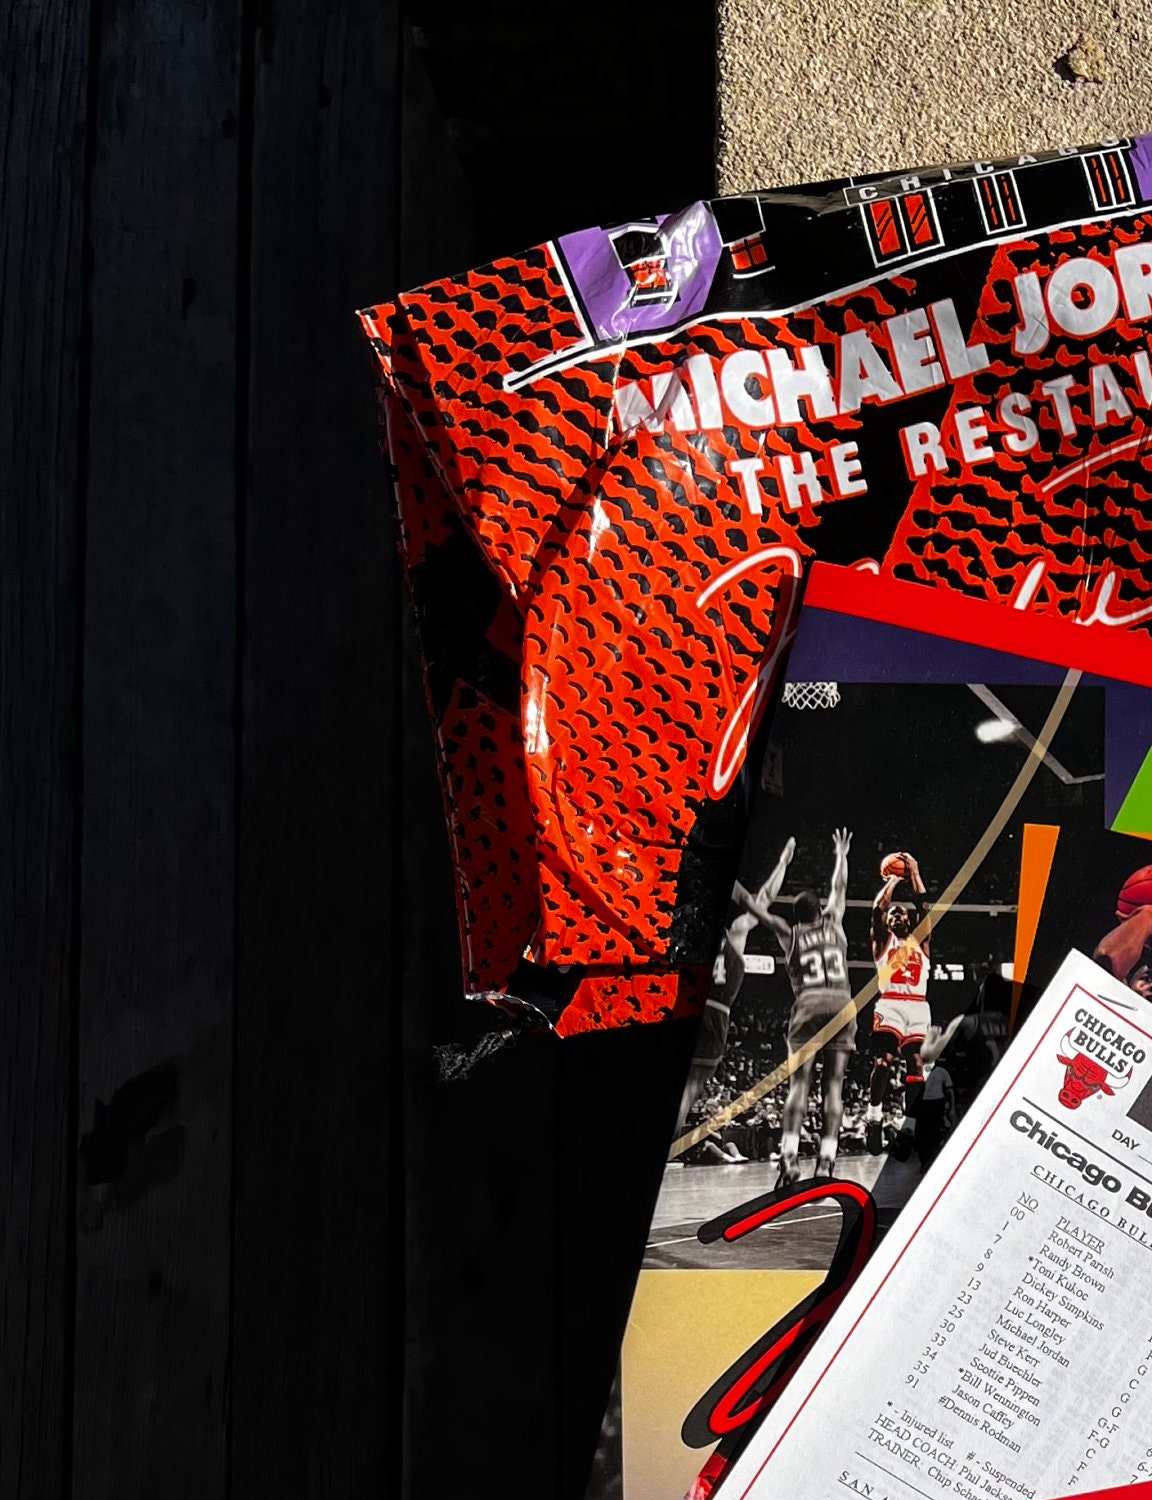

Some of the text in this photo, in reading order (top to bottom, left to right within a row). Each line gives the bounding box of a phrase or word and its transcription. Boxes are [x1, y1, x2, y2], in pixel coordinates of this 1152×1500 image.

[859, 138, 1121, 200] CHICAGO
[615, 298, 990, 439] MICHAEL
[731, 441, 868, 515] THE
[802, 949, 847, 986] 33
[890, 961, 924, 986] 23
[1073, 1030, 1128, 1073] BULLS
[1074, 1008, 1146, 1064] CHICAGO
[1009, 1110, 1121, 1193] Chicago
[1111, 1129, 1140, 1150] DAY
[1016, 1191, 1039, 1212] NO
[1054, 1215, 1105, 1254] PLAYER
[1030, 1165, 1110, 1217] CHICAGO
[993, 1234, 1002, 1244] 7
[1055, 1273, 1088, 1301] Kukoc
[1002, 1221, 1009, 1231] 1
[1039, 1244, 1072, 1272] Randy
[1071, 1264, 1105, 1293] Brown
[1009, 1206, 1025, 1221] 00
[1047, 1230, 1083, 1258] Robert
[1082, 1251, 1114, 1279] Parish
[967, 1277, 981, 1290] 13
[1003, 1300, 1024, 1319] Luc
[1024, 1312, 1066, 1345] Longley
[975, 1262, 984, 1272] 9
[1012, 1286, 1034, 1306] Ron
[1034, 1299, 1071, 1328] Harper
[983, 1248, 993, 1259] 8
[1021, 1271, 1058, 1302] Dickey
[1058, 1295, 1104, 1330] Simpkins
[939, 1318, 1042, 1387] 30 Jud Buechler
[948, 1304, 1040, 1368] 25 Steve Kerr
[956, 1290, 972, 1304] 23
[995, 1313, 1038, 1346] Michael
[1036, 1340, 1069, 1368] Jordan
[912, 1360, 1014, 1429] 35 Jason Caffey
[922, 1346, 937, 1361] 34
[984, 1382, 1040, 1427] Wennington
[930, 1332, 1039, 1407] 33 Scottie Pippen
[900, 1409, 954, 1449] Injured list
[904, 1374, 919, 1389] 91
[979, 1420, 1021, 1453] Rodman
[874, 1413, 911, 1441] HEAD
[957, 1465, 981, 1485] Phil
[927, 1466, 951, 1488] Chip
[981, 1461, 1036, 1500] Suspended
[838, 1470, 874, 1496] SAN
